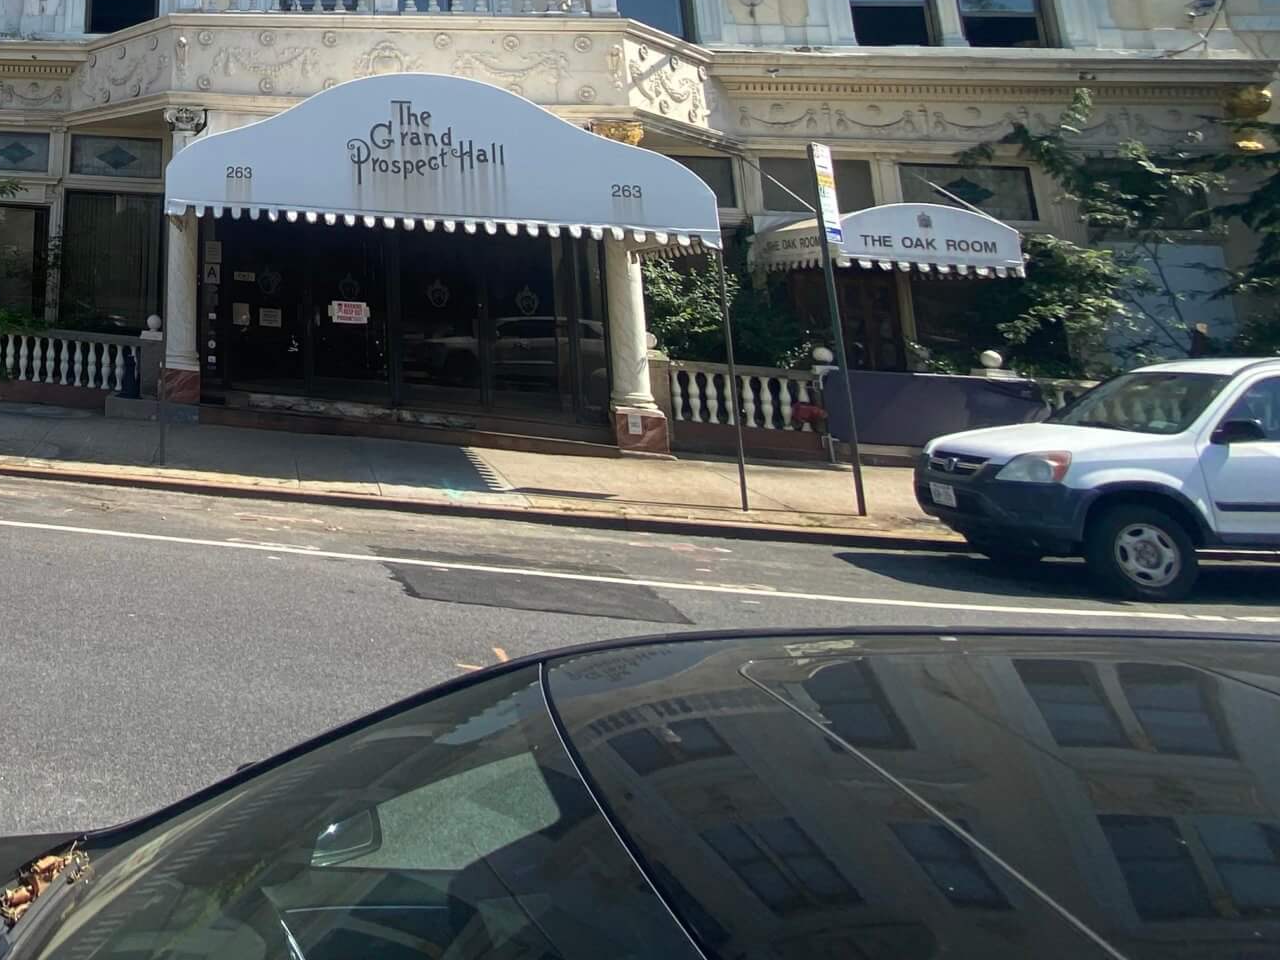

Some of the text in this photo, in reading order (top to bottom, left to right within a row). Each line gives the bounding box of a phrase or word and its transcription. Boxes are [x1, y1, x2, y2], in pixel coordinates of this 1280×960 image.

[391, 100, 431, 127] The
[370, 120, 452, 149] Grand
[347, 138, 504, 185] Prospect Hall
[226, 166, 252, 179] 263
[611, 184, 642, 198] 263
[782, 238, 797, 250] OAK
[860, 234, 997, 254] THE OAK ROOM
[207, 266, 217, 278] A
